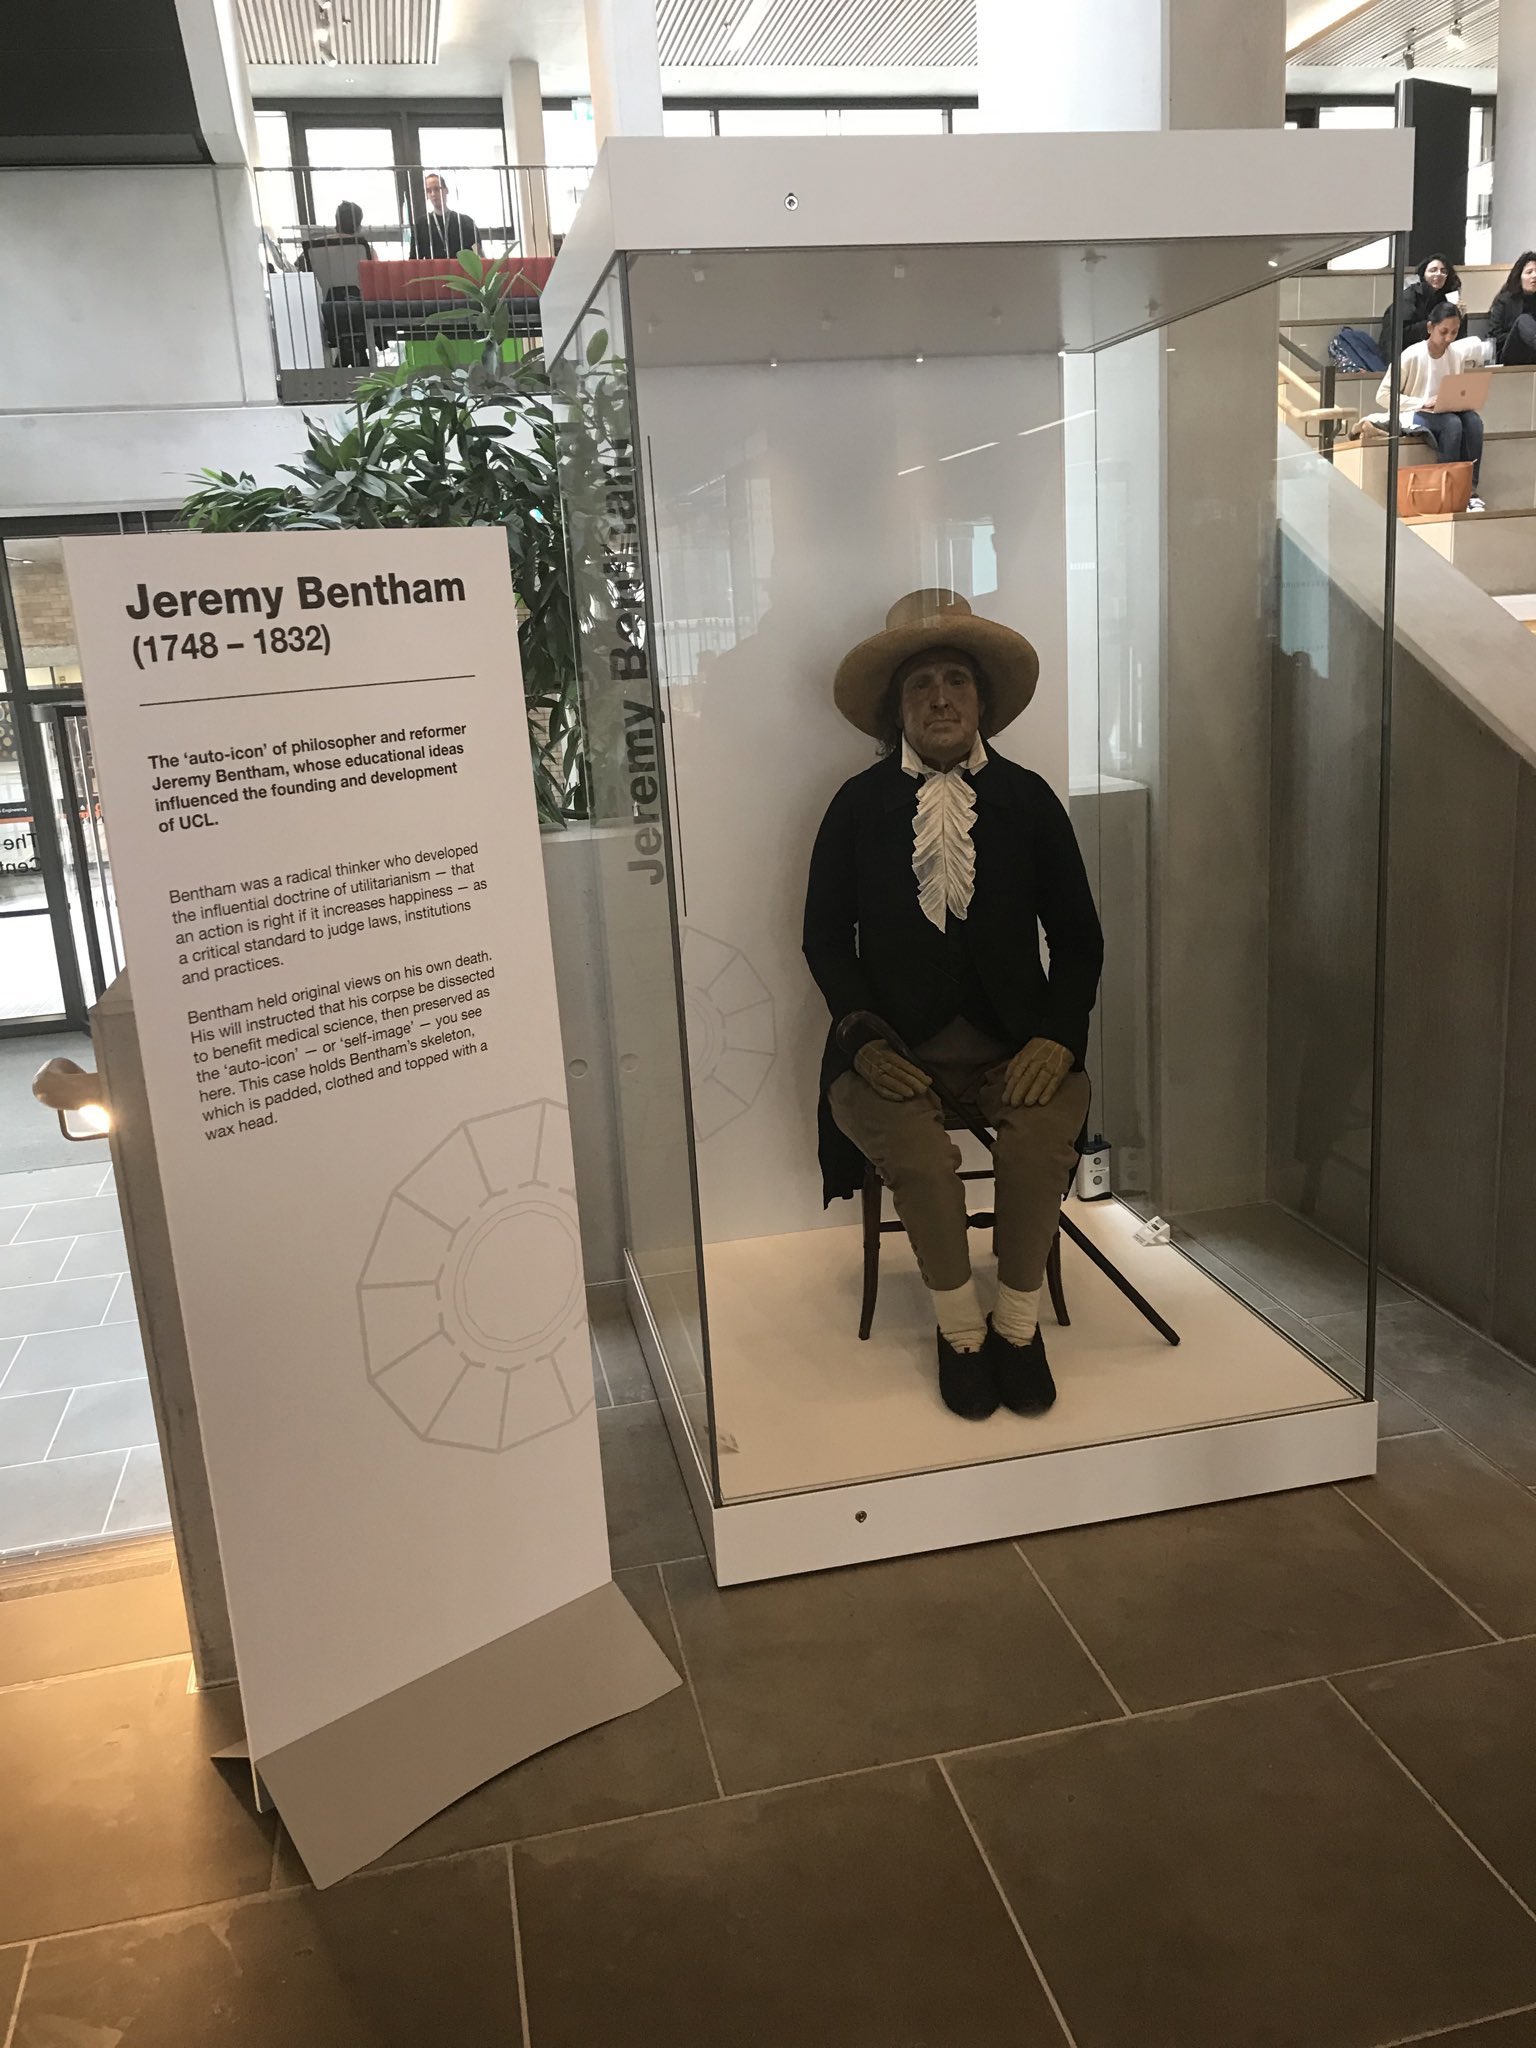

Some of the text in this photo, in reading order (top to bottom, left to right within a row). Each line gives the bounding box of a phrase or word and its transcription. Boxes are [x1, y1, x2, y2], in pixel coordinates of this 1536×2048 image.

[125, 572, 466, 620] Jeremy Bentham
[133, 631, 219, 670] (1748
[253, 623, 331, 656] 1832)
[147, 754, 180, 770] The
[272, 741, 288, 756] of
[291, 733, 377, 757] philosopher
[380, 728, 406, 744] and
[409, 724, 467, 741] reformer
[152, 743, 464, 791] Jeremy Bentham, whose educational ideas
[154, 762, 458, 812] influenced the founding and development
[622, 699, 666, 886] Jeremy
[158, 812, 219, 833] of UCL.
[169, 841, 479, 904] Bentham was a radical thinker who developed
[171, 910, 197, 924] the
[200, 895, 269, 920] influential
[273, 887, 330, 907] doctrine
[333, 881, 347, 897] of
[350, 871, 431, 894] utilitarianism
[450, 861, 475, 877] that
[175, 932, 195, 945] an
[198, 923, 244, 941] action
[246, 918, 260, 932] is
[263, 911, 296, 931] right
[298, 908, 307, 923] if
[310, 907, 320, 920] it
[323, 899, 386, 918] increases
[388, 886, 453, 907] happiness
[473, 880, 488, 891] as
[178, 901, 472, 965] a critical standard to judge laws, institutions
[181, 956, 284, 985] and practices.
[187, 950, 492, 1025] Bentham held original views on his own death.
[190, 967, 495, 1044] His will instructed that his corpse be dissected
[193, 988, 490, 1064] to benefit medical science, then preserved as
[196, 1069, 221, 1083] the
[322, 1041, 337, 1054] or
[434, 1013, 458, 1030] you
[460, 1008, 482, 1020] see
[198, 1086, 236, 1103] here.
[238, 1075, 270, 1093] This
[273, 1068, 306, 1085] case
[308, 1057, 347, 1076] holds
[420, 1028, 475, 1049] skeleton,
[202, 1042, 488, 1122] which is padded, clothed and topped with a
[204, 1111, 278, 1141] wax head.
